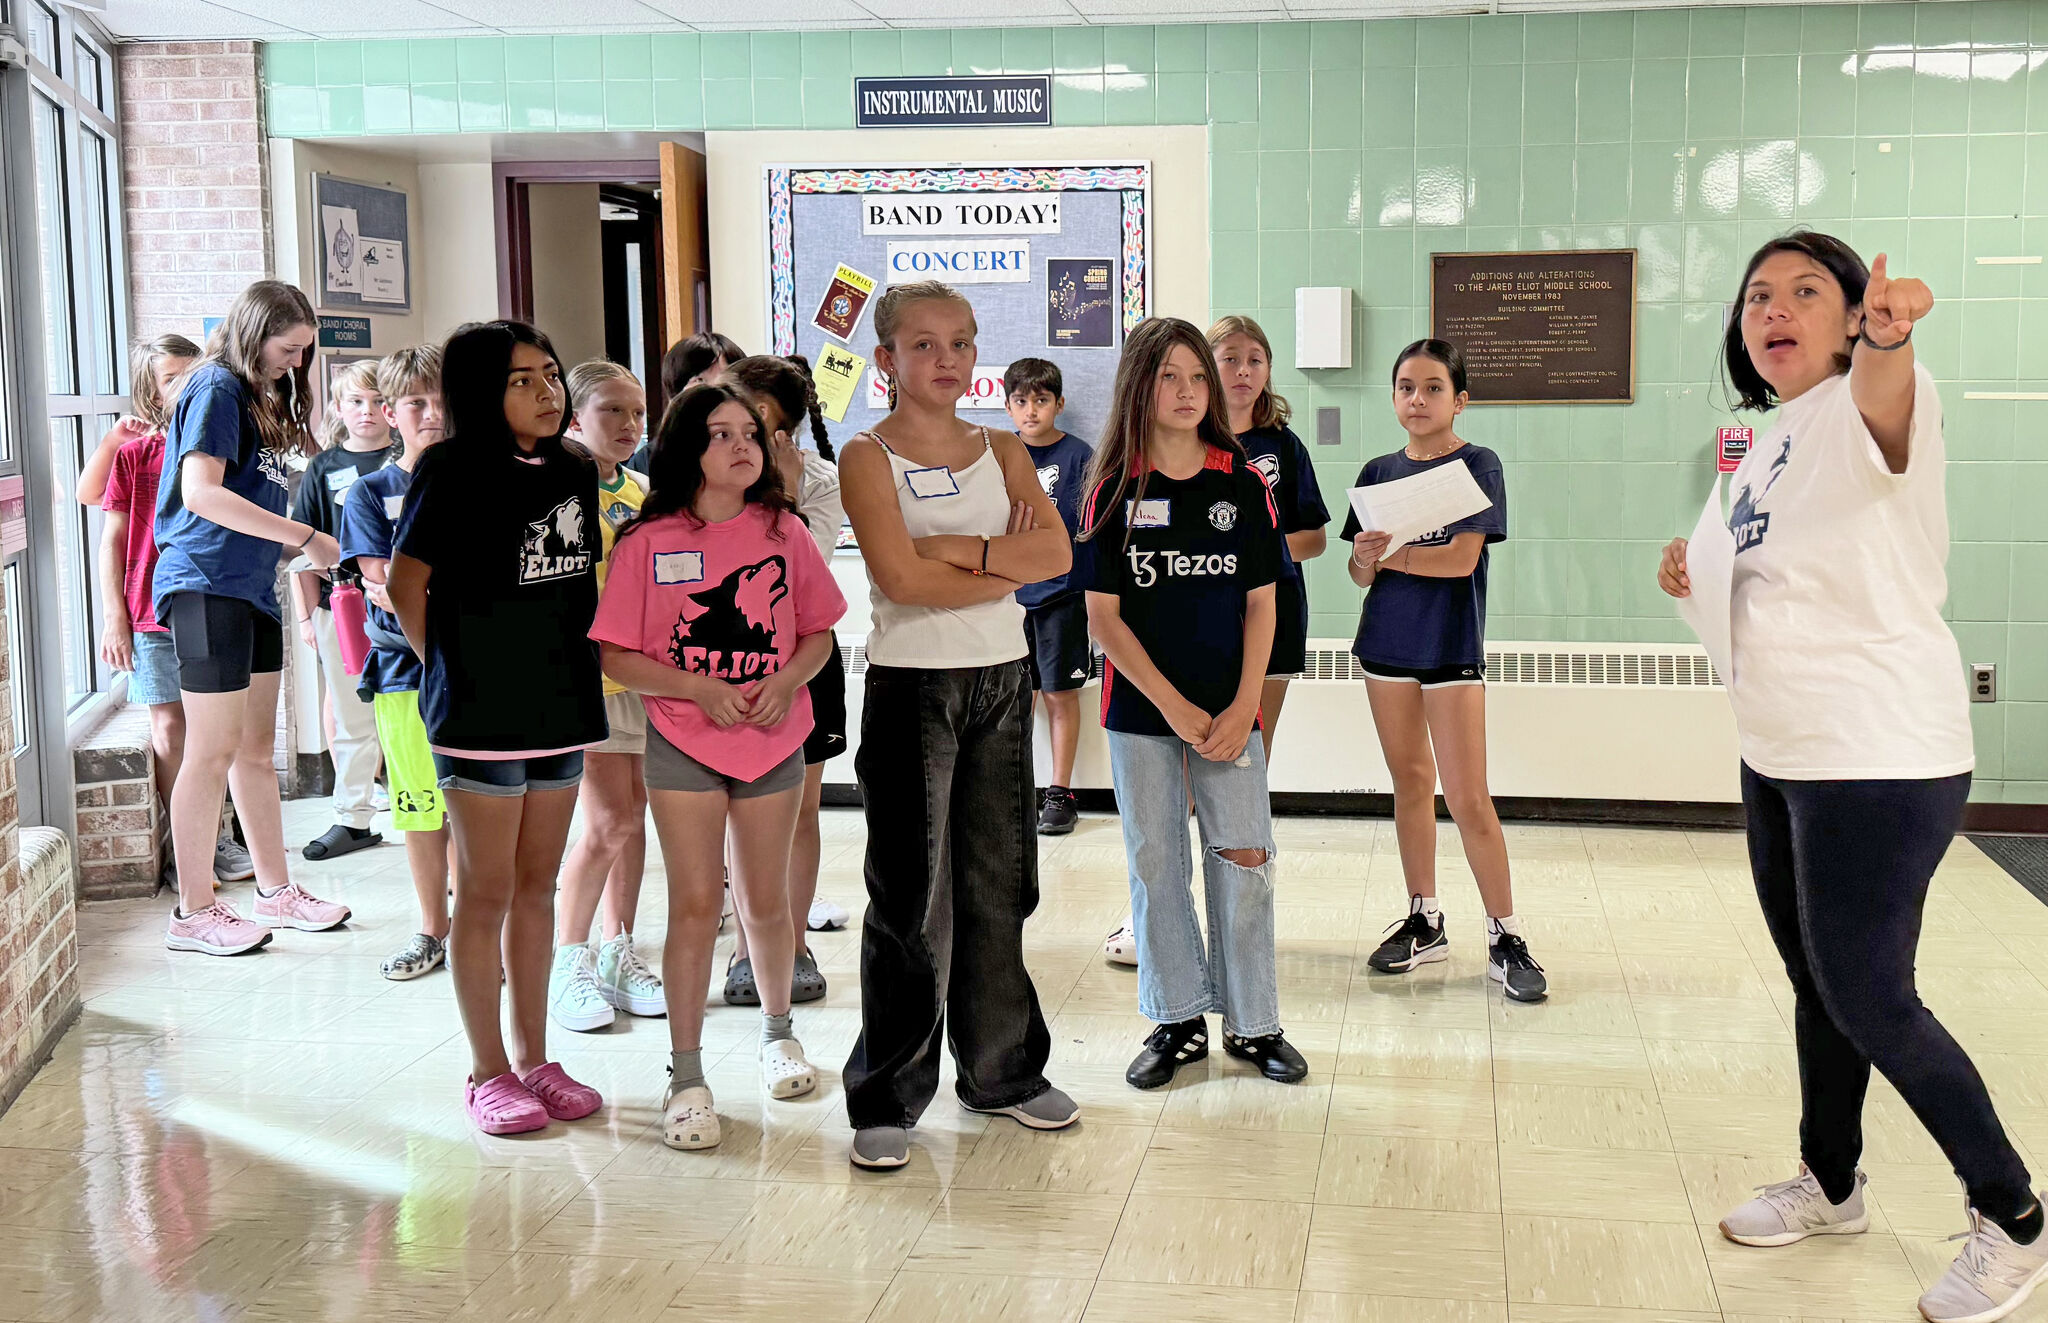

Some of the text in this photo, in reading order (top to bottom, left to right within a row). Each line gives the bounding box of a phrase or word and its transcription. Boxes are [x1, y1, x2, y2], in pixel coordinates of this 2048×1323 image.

[863, 88, 1043, 116] INSTRUMENTAL MUSIC
[868, 203, 1059, 226] BAND TODAY!
[892, 250, 1026, 272] CONCERT
[838, 266, 874, 288] PLAYBILL
[1083, 275, 1108, 283] CONCERT
[1087, 268, 1108, 276] SPRING
[1470, 270, 1596, 281] ADDITIONS AND ALTERATIONS
[1453, 280, 1613, 292] TO THE JARED ELIOT MIDDLE SCHOOL
[1502, 292, 1562, 301] NOVEMBER 1983
[334, 331, 358, 341] ROOMS
[1722, 429, 1750, 439] FIRE
[524, 555, 588, 580] ELIOT
[1160, 550, 1238, 577] Tezos
[682, 646, 779, 679] ELIOT
